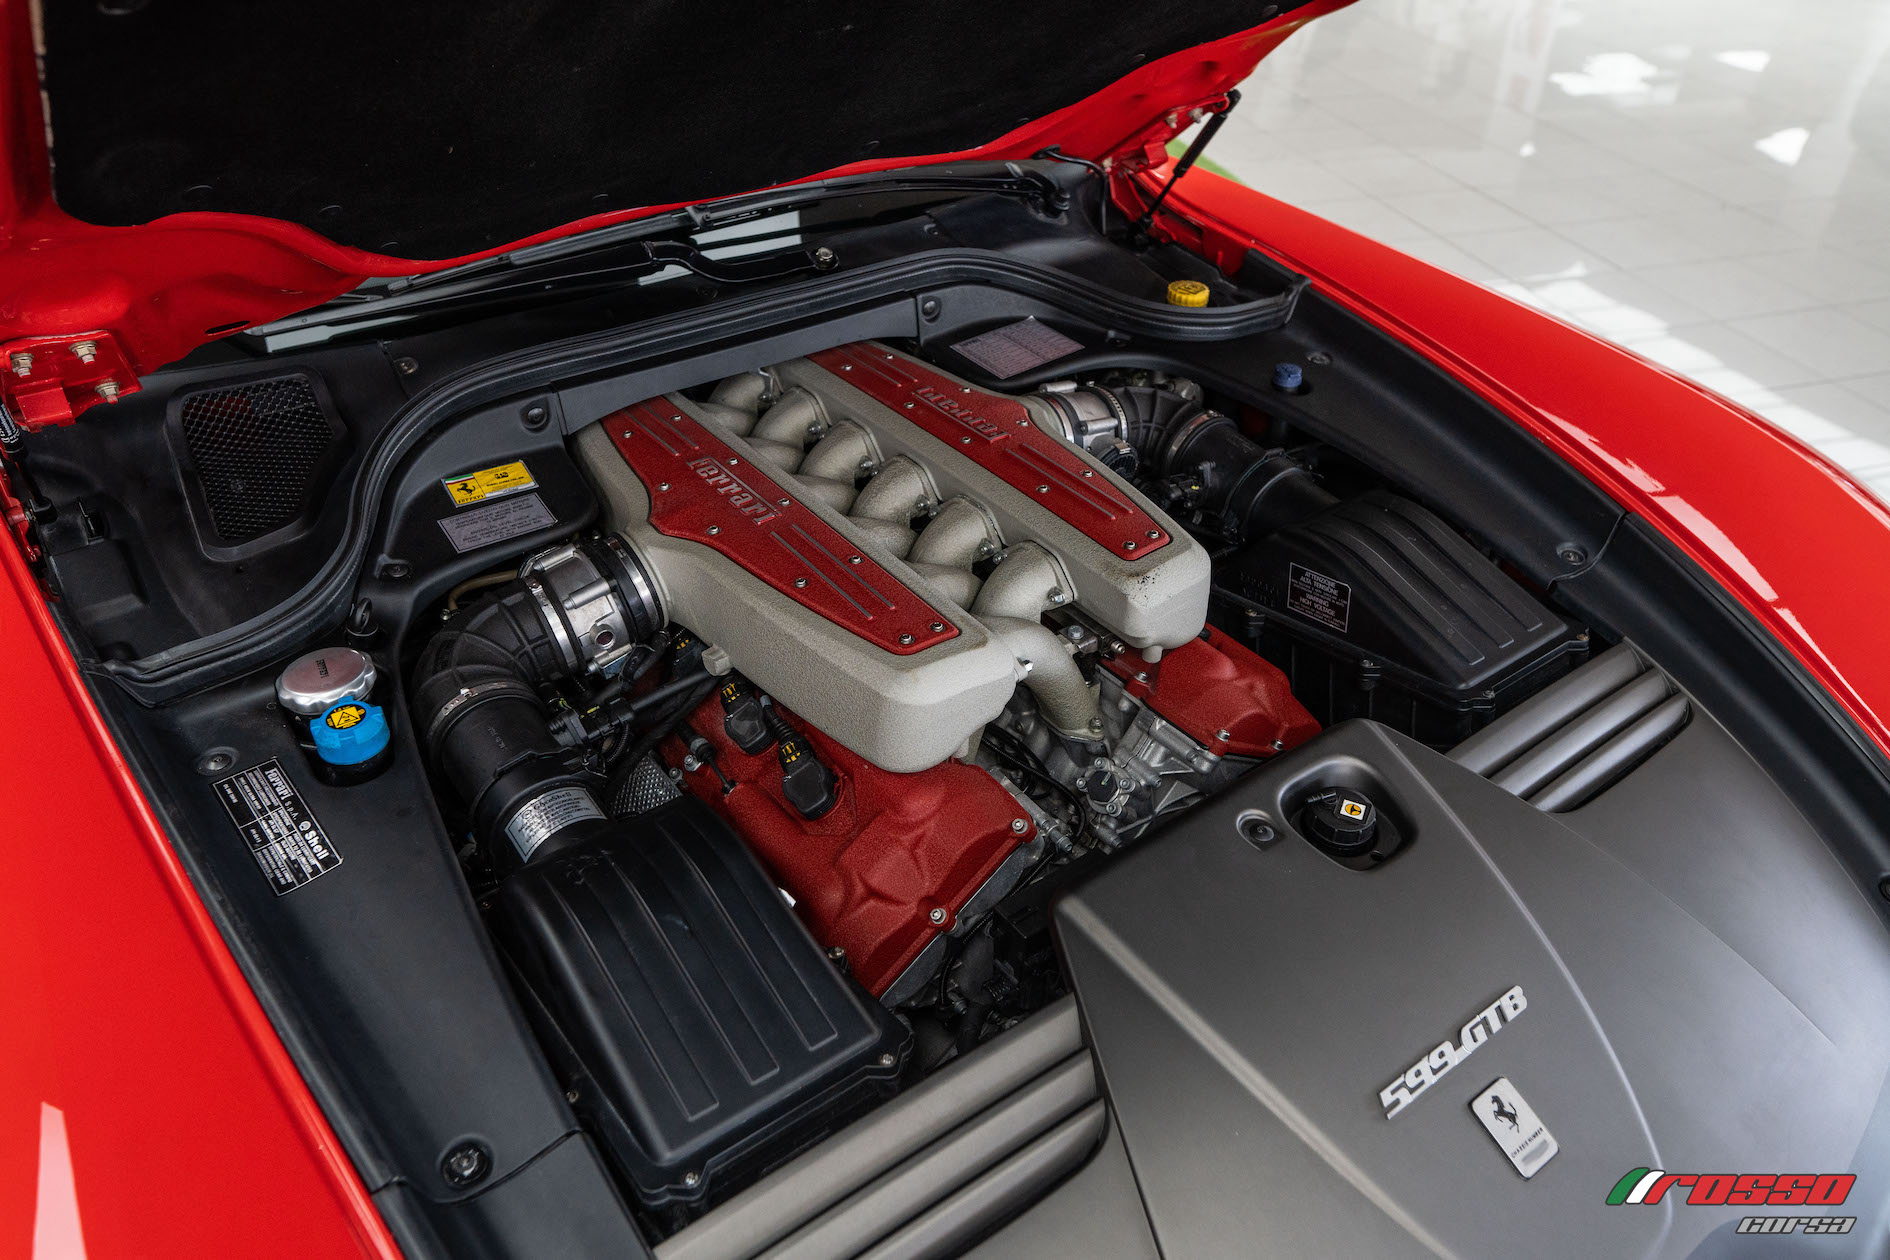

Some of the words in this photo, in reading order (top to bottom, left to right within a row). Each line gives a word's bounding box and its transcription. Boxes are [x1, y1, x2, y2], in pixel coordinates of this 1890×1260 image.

[911, 386, 1011, 443] Ferrari
[686, 456, 781, 525] Ferrari
[265, 767, 294, 801] Ferrari
[304, 830, 330, 860] Shell
[1379, 1040, 1457, 1120] 599
[1460, 985, 1528, 1053] GTB
[1511, 1139, 1529, 1158] CHASSIS
[1528, 1127, 1544, 1143] NUMBER
